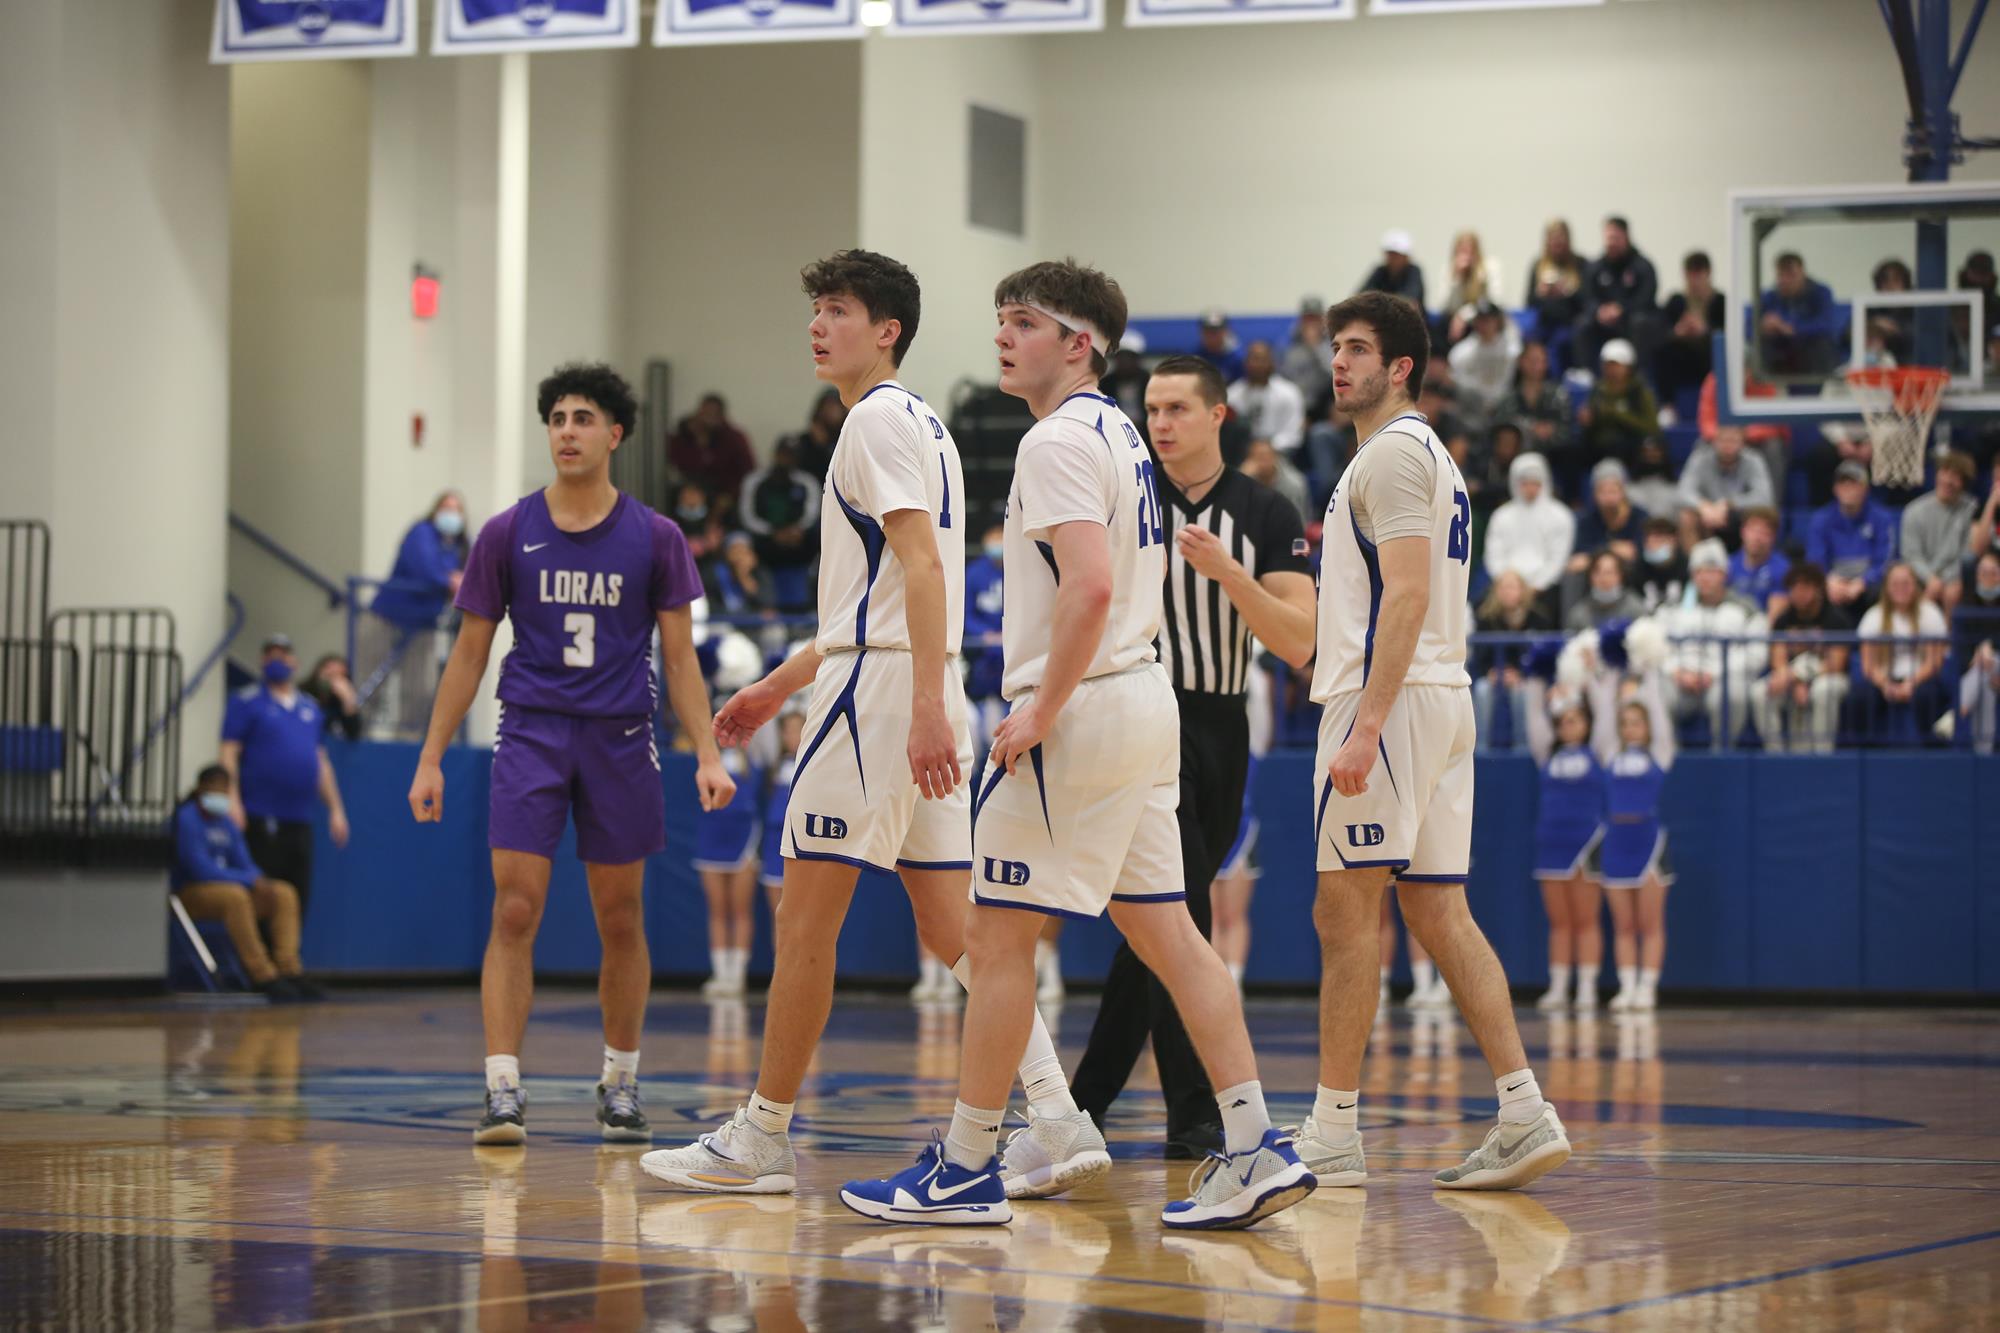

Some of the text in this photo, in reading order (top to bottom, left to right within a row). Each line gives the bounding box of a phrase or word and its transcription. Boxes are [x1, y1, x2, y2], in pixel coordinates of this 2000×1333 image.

[939, 452, 952, 528] 1
[1135, 459, 1163, 549] 20
[540, 569, 623, 607] LORAS
[563, 612, 595, 668] 3
